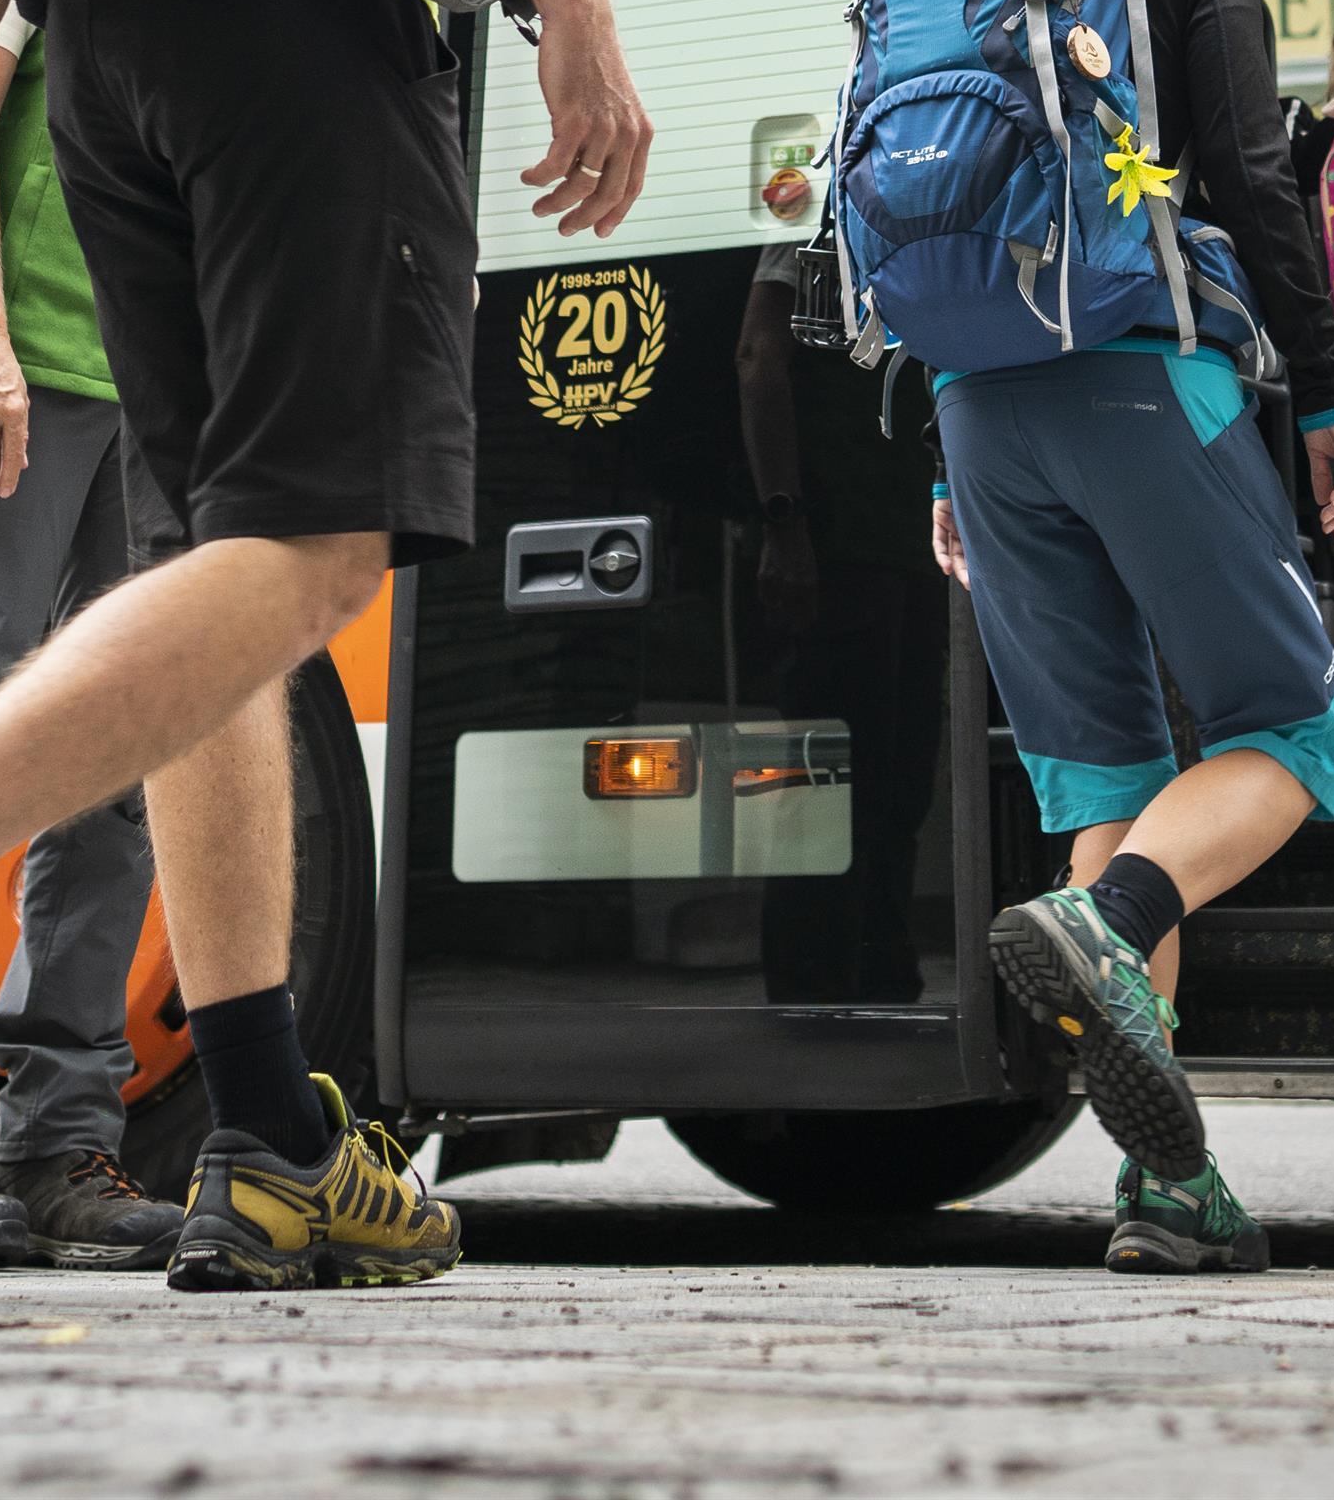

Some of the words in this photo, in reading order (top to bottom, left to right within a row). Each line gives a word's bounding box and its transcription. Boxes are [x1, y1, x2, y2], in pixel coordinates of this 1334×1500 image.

[560, 269, 627, 290] 1998-2018
[555, 289, 628, 358] 20
[567, 358, 614, 377] Jahre
[563, 381, 618, 408] HPV
